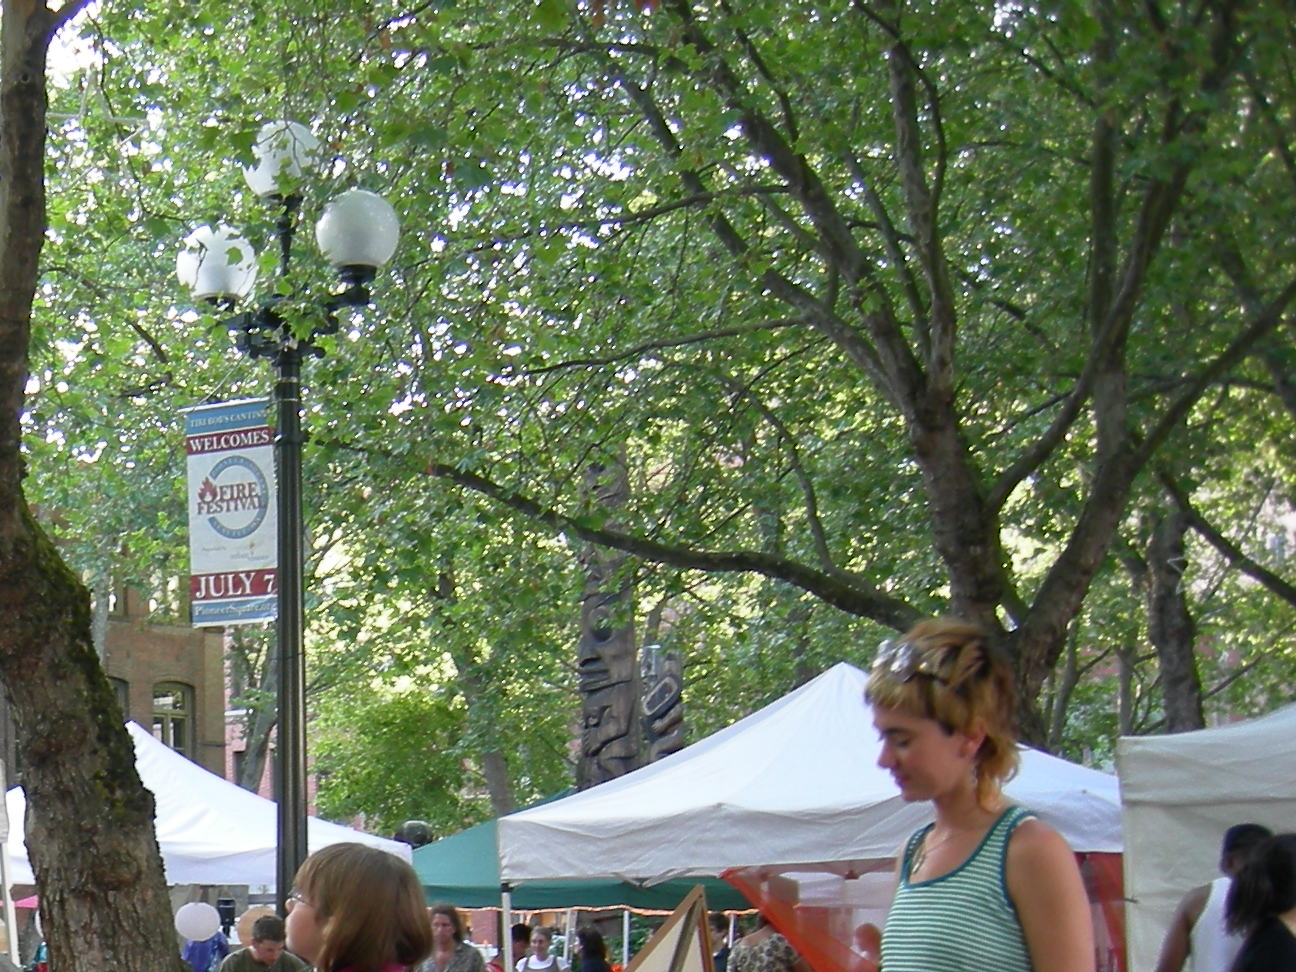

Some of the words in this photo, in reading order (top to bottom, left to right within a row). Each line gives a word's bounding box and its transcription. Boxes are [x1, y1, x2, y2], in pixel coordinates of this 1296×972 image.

[189, 430, 270, 452] WELCOMES
[218, 482, 259, 502] FIRE
[197, 495, 266, 515] FESTIVAL
[195, 572, 256, 599] JULY
[264, 574, 275, 593] 7
